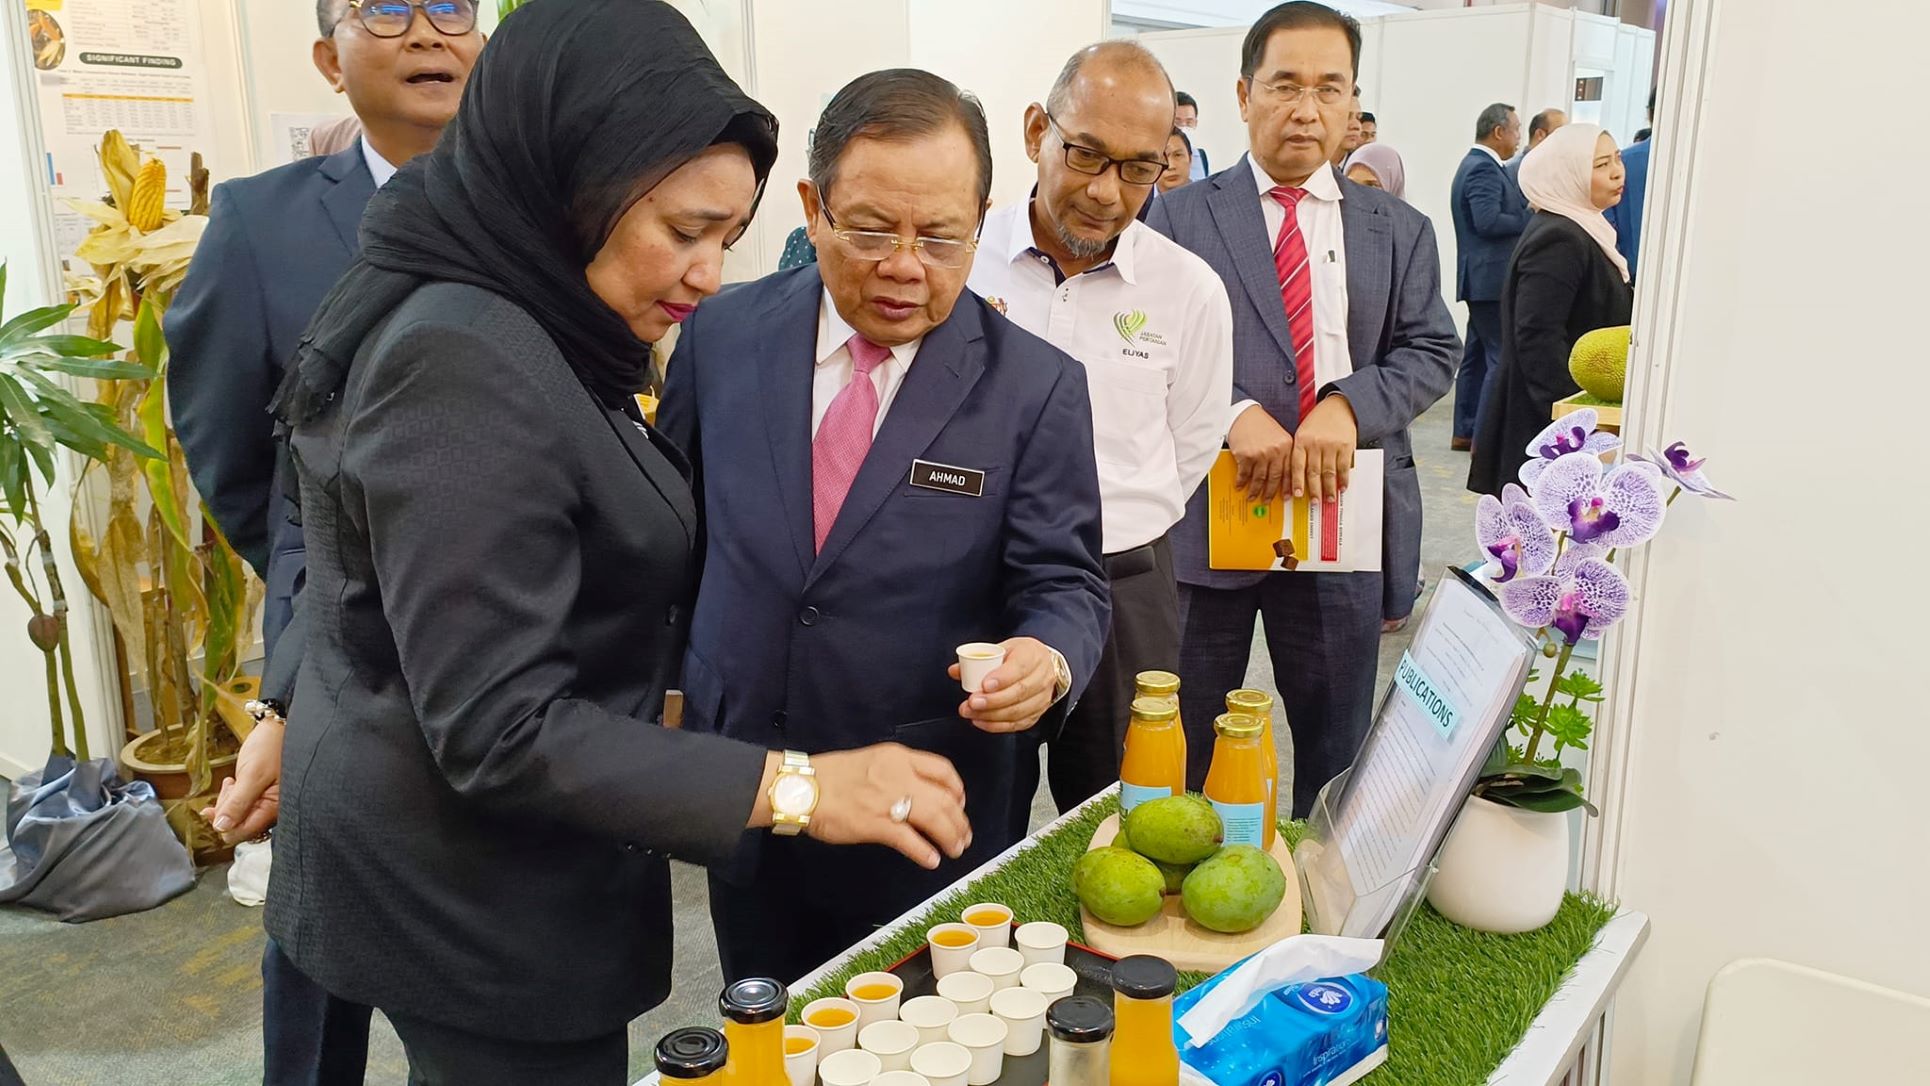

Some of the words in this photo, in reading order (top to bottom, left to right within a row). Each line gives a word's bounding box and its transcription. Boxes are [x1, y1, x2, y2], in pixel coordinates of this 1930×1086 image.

[86, 54, 140, 64] SIGNIFICANT
[142, 57, 177, 66] FINDING
[929, 470, 966, 486] AHMAD
[1399, 658, 1453, 728] PUBLICATIONS
